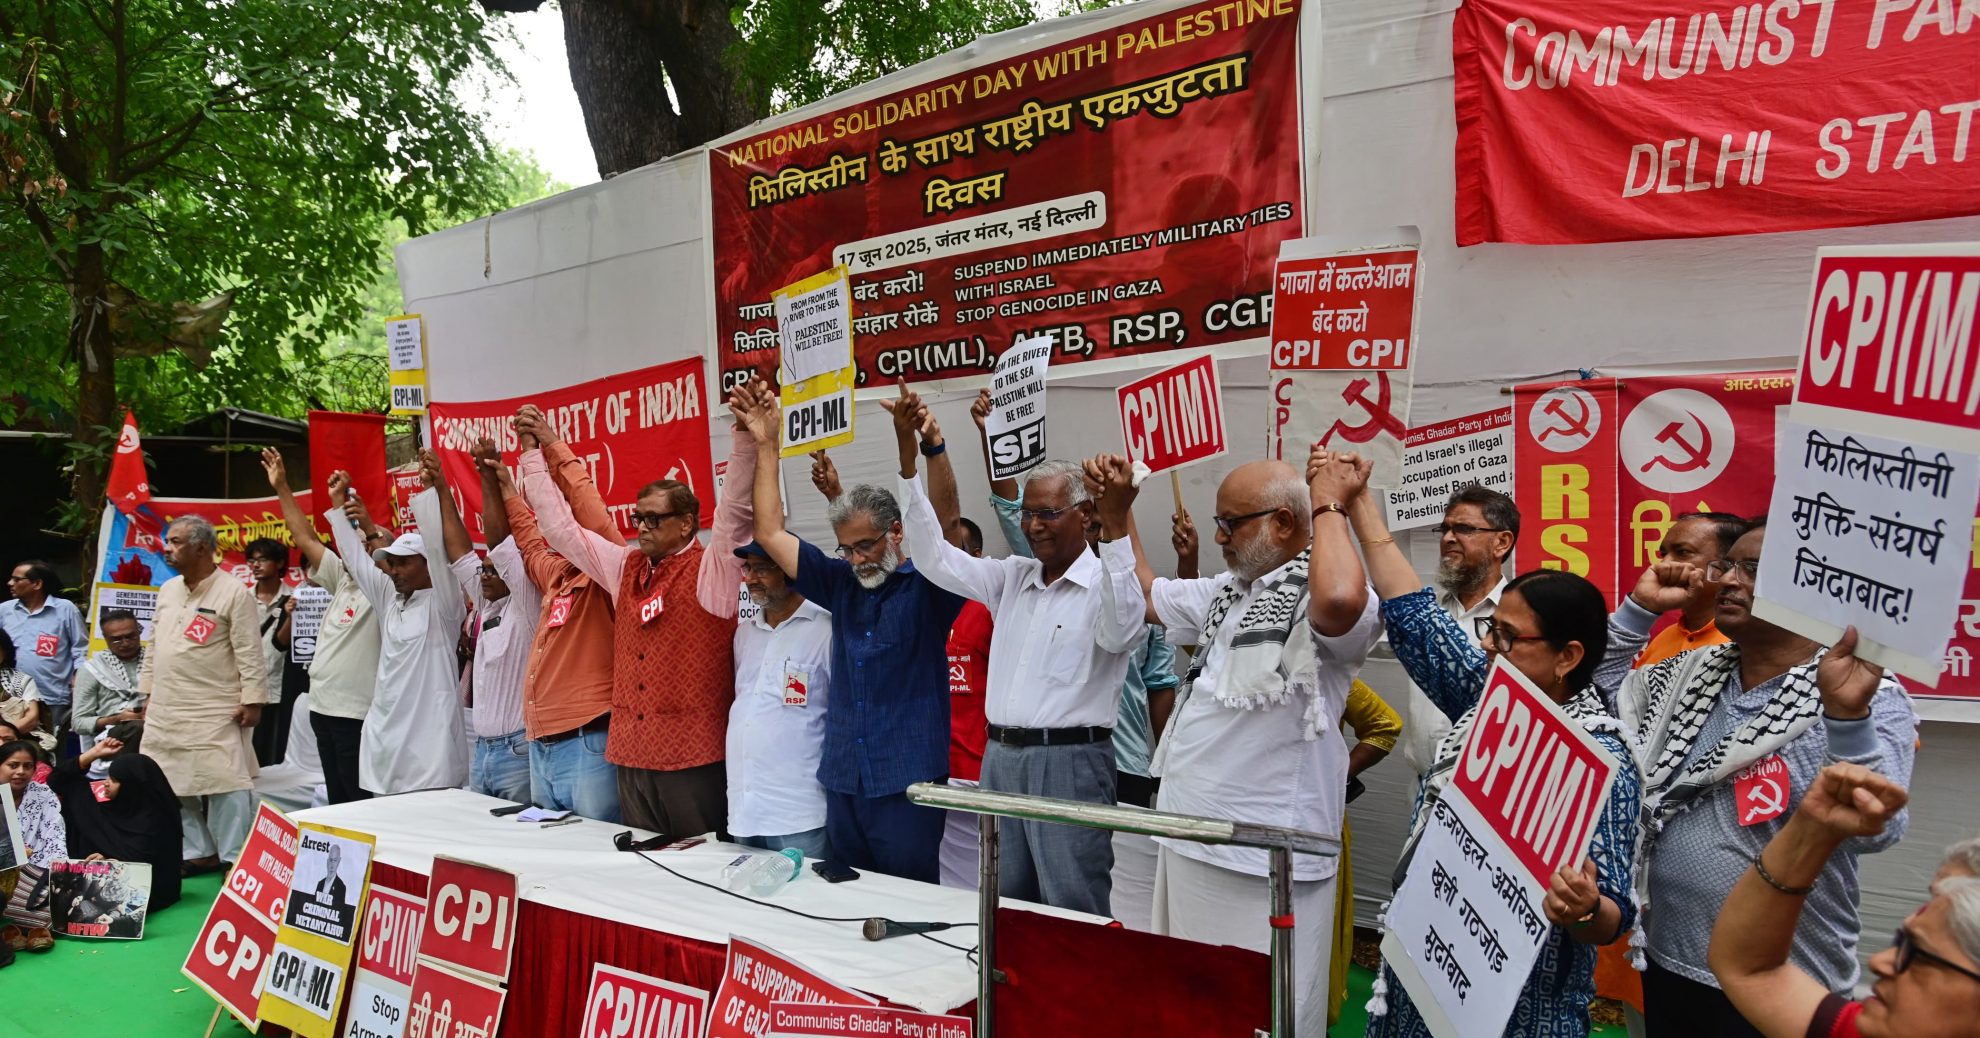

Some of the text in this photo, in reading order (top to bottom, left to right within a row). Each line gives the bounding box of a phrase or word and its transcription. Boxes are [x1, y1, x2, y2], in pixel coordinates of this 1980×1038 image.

[1502, 0, 1836, 91] COMMUNIST
[729, 0, 1294, 168] NATIONAL SOLIDARITY DAY WITH PALESTINE
[749, 56, 1247, 207] फिलिस्तीन के साथ राष्ट्रीय एकजुटता
[1622, 129, 1772, 198] DELHI
[925, 173, 1005, 213] दिवस
[858, 246, 882, 267] जून
[885, 237, 931, 259] 2025,
[935, 229, 971, 248] जंतर
[974, 221, 1013, 241] मंतर,
[1017, 210, 1042, 232] नई
[1046, 199, 1098, 228] दिल्ली
[954, 203, 1292, 281] SUSPEND IMMEDIATELY MILITARY TIES
[853, 280, 879, 300] बंद
[882, 270, 924, 296] करो!
[955, 274, 1055, 302] WITH ISRAEL
[1280, 270, 1317, 295] गाजा
[1318, 261, 1336, 293] में
[789, 298, 840, 322] RIVER TO THE SEA
[790, 287, 838, 312] FROM FROM THE
[956, 279, 1163, 324] STOP GENOCIDE IN GAZA
[795, 318, 839, 341] PALESTINE
[852, 312, 899, 335] संहार
[902, 300, 939, 327] रोकें
[1312, 300, 1369, 334] बंद करो
[794, 329, 843, 352] WILL BE FREE!
[878, 338, 995, 375] CPI(ML),
[1113, 311, 1185, 345] RSP,
[1273, 338, 1405, 367] CPI CPI
[1007, 346, 1049, 368] THE RIVER
[989, 379, 1044, 408] PALESTINE WILL
[994, 365, 1034, 390] TO THE SEA
[394, 387, 423, 407] CPI-ML
[433, 415, 524, 453] COMMUNIS
[605, 390, 632, 435] OF
[638, 372, 701, 429] INDIA
[1005, 401, 1035, 423] BE FREE!
[788, 396, 847, 442] CPI-ML
[1123, 365, 1218, 462] CPI(M)
[992, 420, 1045, 465] SFI
[1404, 432, 1425, 445] unist
[1426, 425, 1457, 439] Ghadar
[1458, 420, 1482, 433] Party
[1483, 415, 1493, 427] of
[1425, 443, 1466, 462] Israel's
[1468, 433, 1503, 452] illegal
[1463, 459, 1475, 472] of
[1478, 454, 1508, 468] Gaza
[1804, 429, 1955, 499] फिलिस्तीनी
[1390, 491, 1419, 505] Strip,
[1420, 483, 1450, 498] West
[1452, 476, 1480, 492] Bank
[1484, 471, 1506, 486] and
[1397, 502, 1448, 521] Palestinia
[641, 596, 663, 622] CPI
[949, 684, 971, 692] PI-ML
[1465, 683, 1598, 868] CPI(M)
[256, 815, 282, 846] NATIONAL
[301, 835, 331, 854] Arrest
[258, 850, 274, 873] WITH
[231, 868, 264, 904] CPI
[315, 891, 334, 906] WAR
[1431, 860, 1459, 907] खूनी
[295, 914, 344, 938] NETANYAHU!
[302, 902, 341, 923] CRIMINAL
[433, 883, 509, 951] CPI
[364, 897, 426, 976] CPI(M
[205, 919, 272, 1000] CPI
[271, 951, 336, 1011] CPI-ML
[732, 952, 753, 986] WE
[751, 961, 803, 1003] SUPPORT
[372, 994, 400, 1025] Stop
[724, 995, 746, 1027] OF
[776, 1010, 967, 1038] Communist Ghadar Party of India
